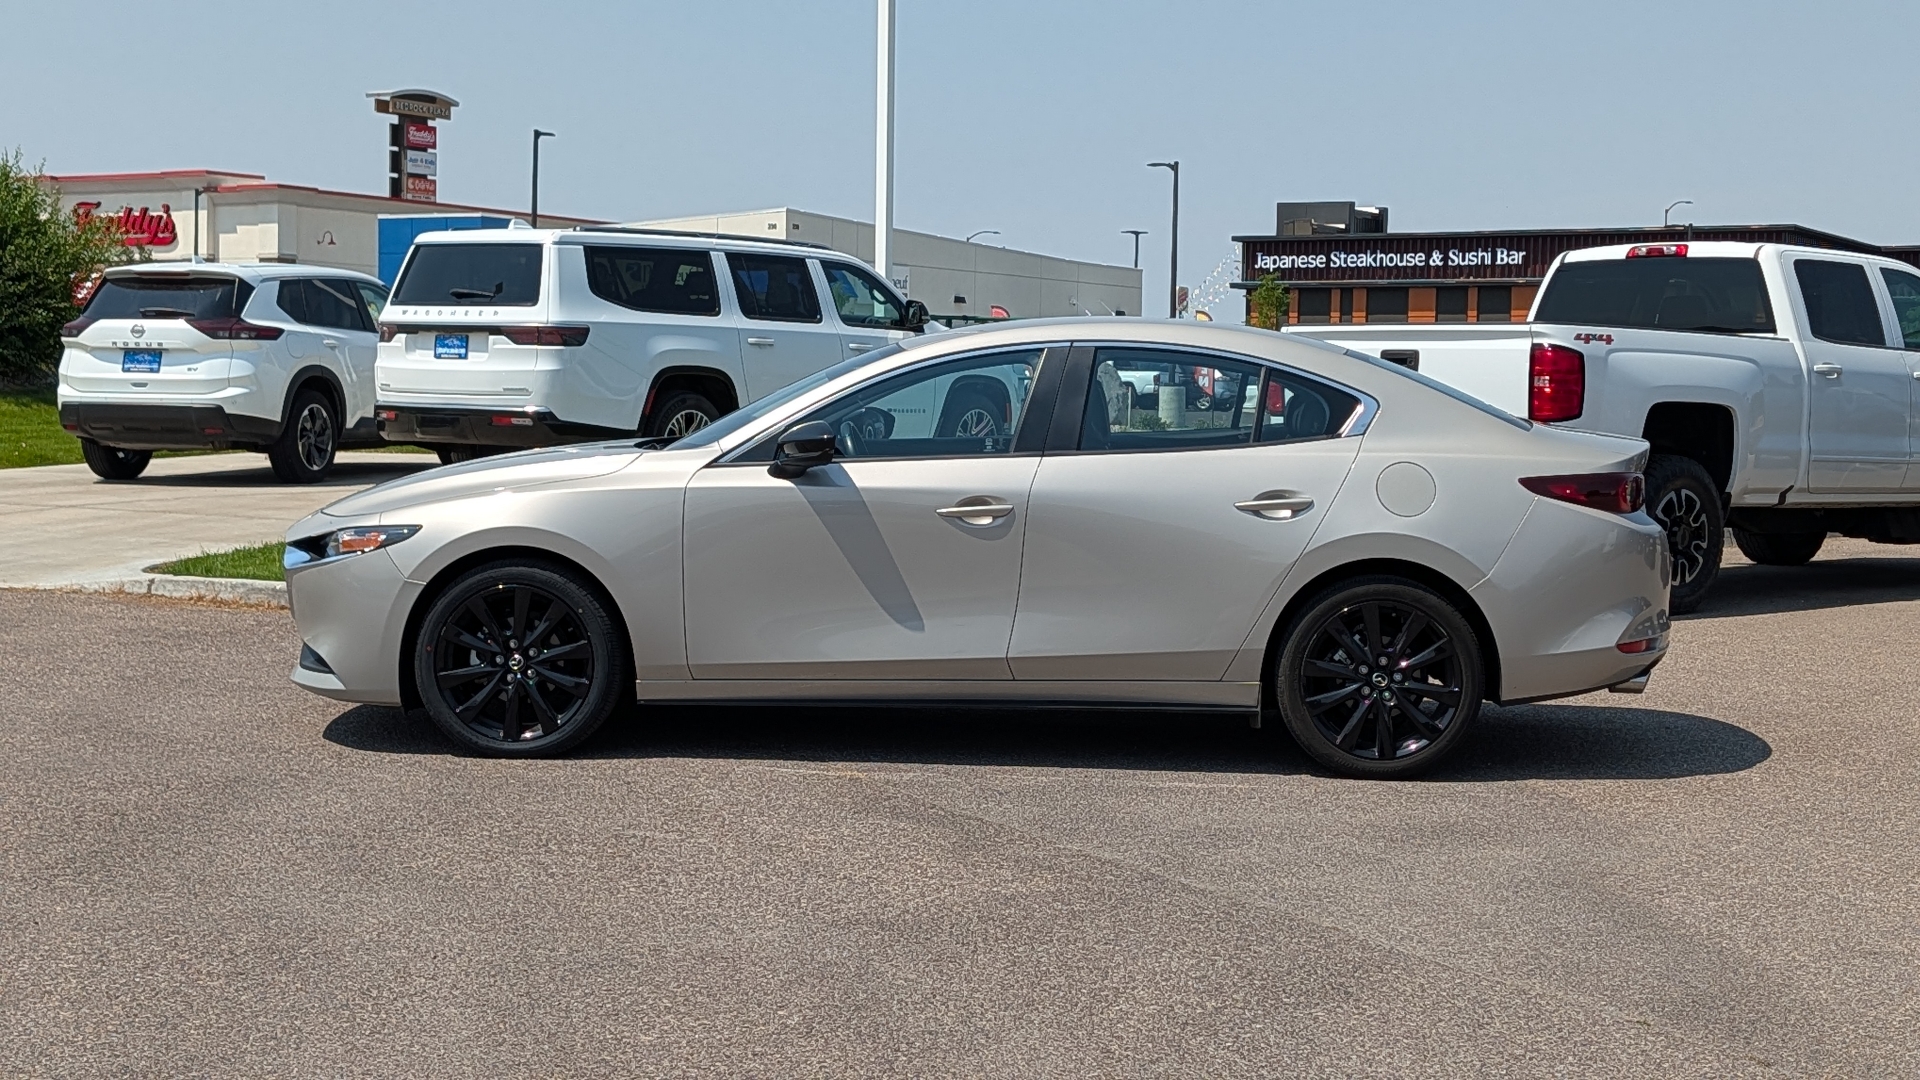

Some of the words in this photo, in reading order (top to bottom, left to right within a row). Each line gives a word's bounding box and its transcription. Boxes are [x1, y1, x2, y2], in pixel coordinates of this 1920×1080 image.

[1254, 252, 1327, 272] Japanese
[1330, 249, 1426, 268] Steakhouse
[1429, 249, 1444, 267] &
[1448, 247, 1492, 266] Sushi
[1495, 247, 1526, 265] Bar
[401, 309, 499, 317] WAGONEER
